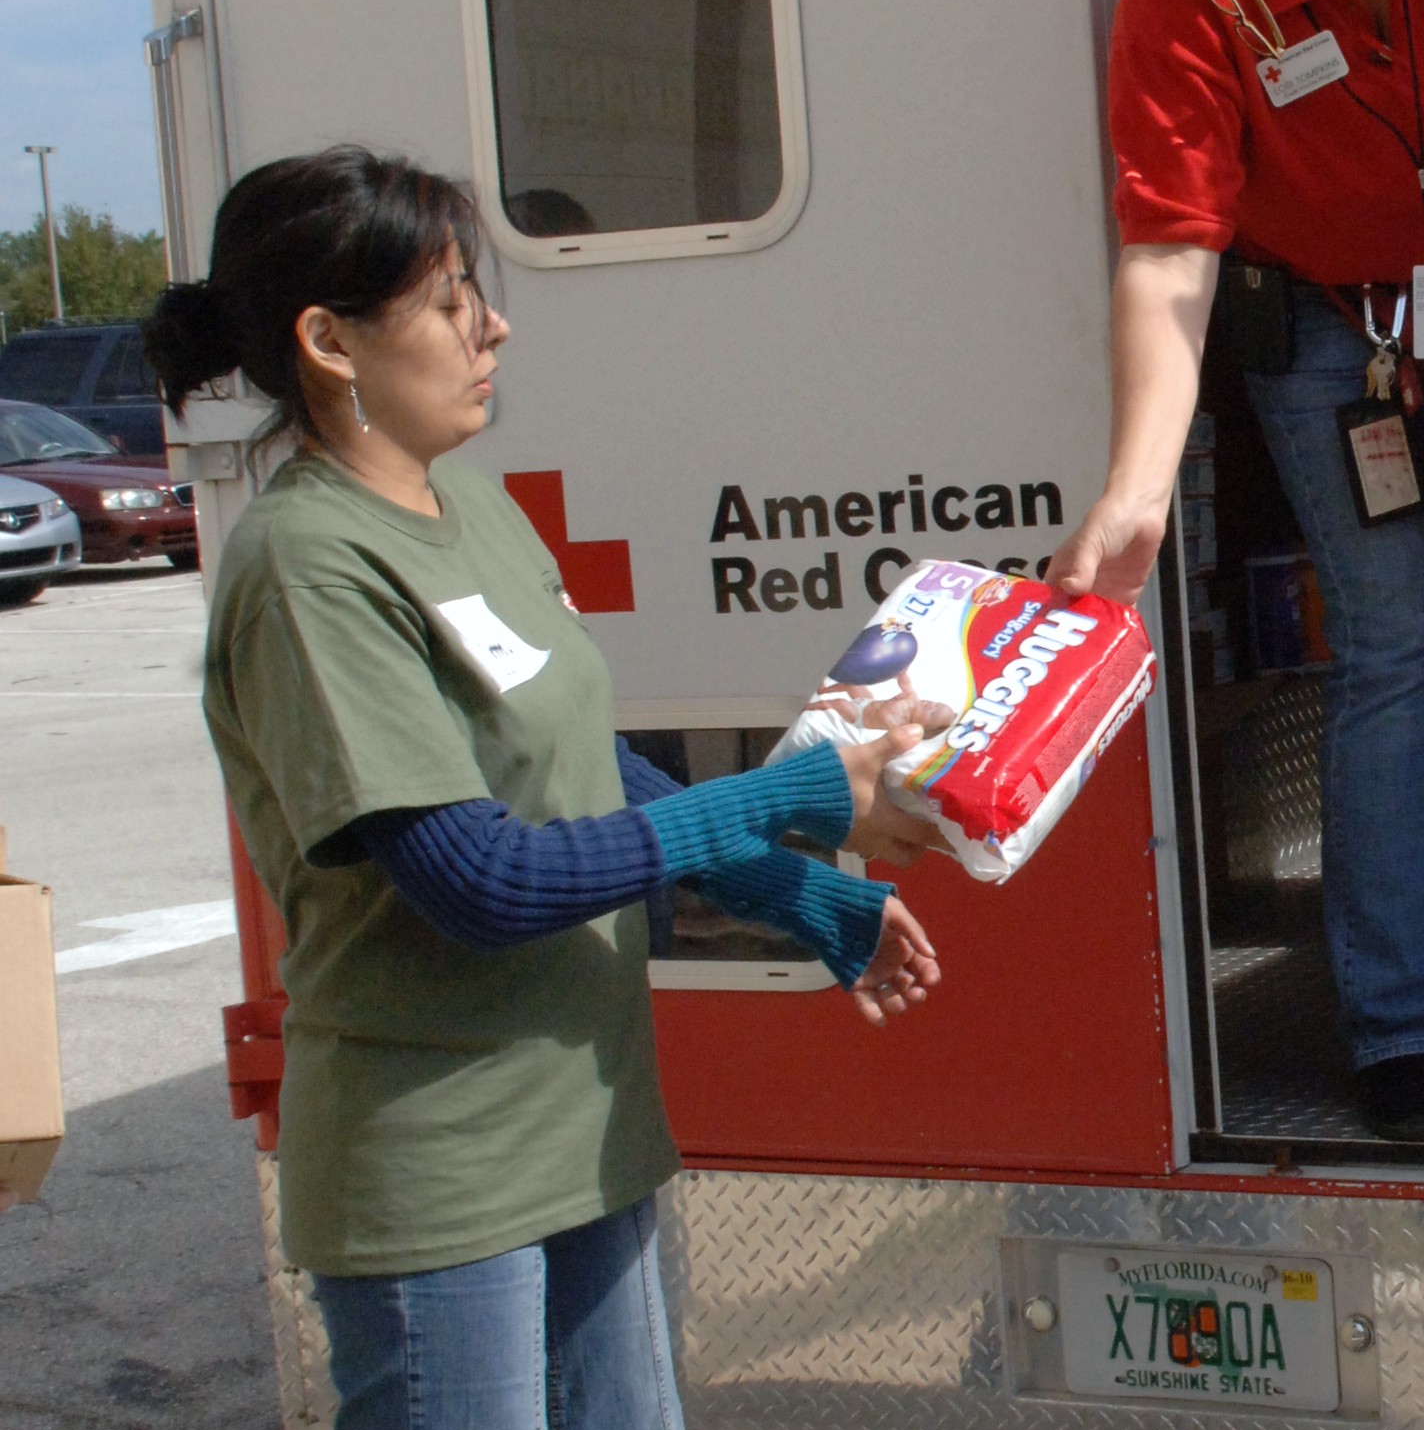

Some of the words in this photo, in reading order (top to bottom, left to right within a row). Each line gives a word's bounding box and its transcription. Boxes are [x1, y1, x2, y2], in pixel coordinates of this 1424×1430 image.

[709, 473, 1064, 543] American
[710, 552, 844, 614] Red
[908, 593, 936, 617] 27
[946, 608, 1099, 753] HUGGIES
[1118, 1261, 1271, 1294] MYFLORIDA.COM
[1126, 1369, 1210, 1392] SUNSHINE
[1219, 1374, 1273, 1396] STATE
